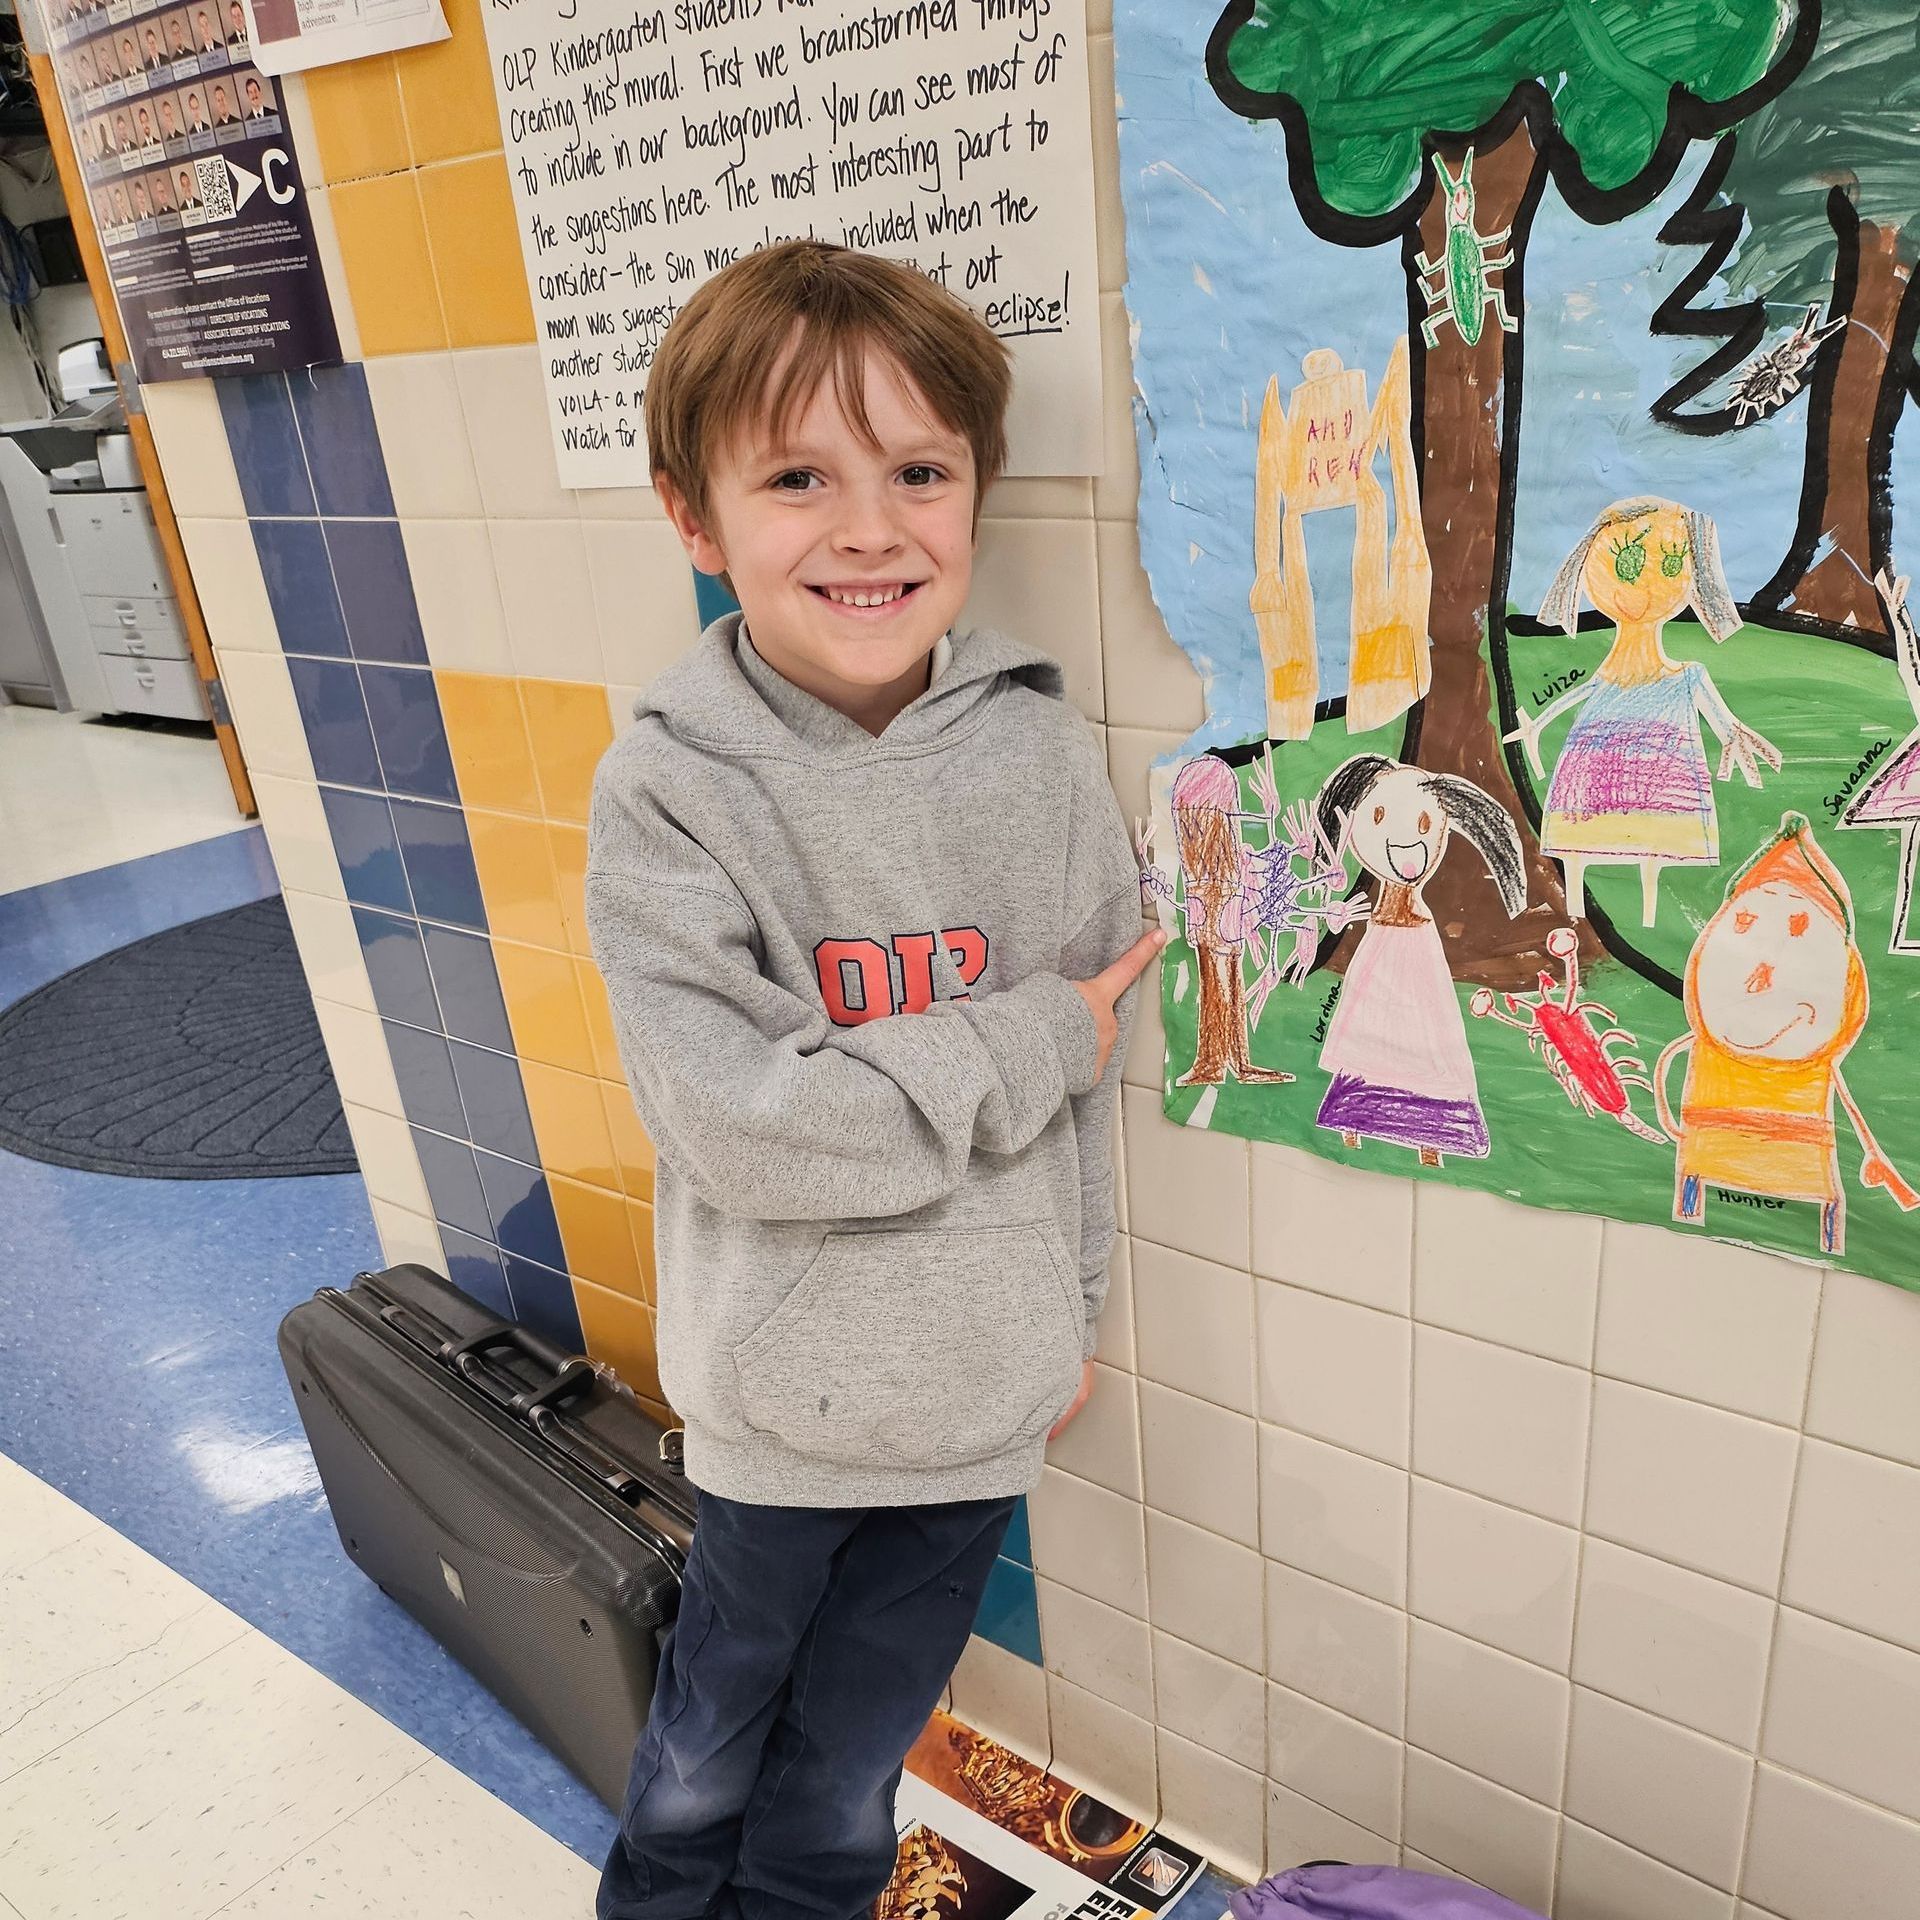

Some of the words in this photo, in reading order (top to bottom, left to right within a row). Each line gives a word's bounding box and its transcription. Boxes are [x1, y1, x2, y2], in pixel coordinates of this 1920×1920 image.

[503, 48, 536, 91] OLP
[550, 10, 667, 87] Kindergarten
[582, 80, 617, 125] this
[624, 55, 684, 107] mural.
[700, 46, 744, 93] First
[754, 43, 788, 78] we
[800, 0, 957, 63] brainstormed
[518, 156, 538, 196] to
[544, 140, 605, 187] include
[610, 134, 632, 169] in
[639, 129, 668, 164] our
[682, 84, 812, 168] background.
[967, 43, 1025, 96] most
[1035, 33, 1066, 85] of
[261, 147, 296, 205] C
[532, 214, 558, 256] the
[566, 196, 656, 255] suggestions
[662, 184, 710, 225] here.
[715, 165, 758, 212] The
[771, 153, 819, 199] most
[829, 134, 941, 192] interesting
[955, 112, 1012, 180] part
[1025, 109, 1049, 151] to
[839, 200, 918, 249] included
[925, 193, 982, 236] when
[990, 187, 1039, 226] the
[240, 308, 268, 321] VOCATIONS
[245, 292, 270, 305] Vocations
[545, 314, 580, 340] moon
[586, 312, 615, 337] was
[623, 295, 683, 347] suggest
[966, 244, 1003, 290] out
[551, 348, 603, 379] another
[613, 343, 657, 373] stude
[985, 270, 1070, 334] eclipse!
[561, 422, 611, 451] Watch
[615, 417, 636, 447] for
[1823, 737, 1891, 816] Savanna
[1718, 1189, 1786, 1209] Hunter
